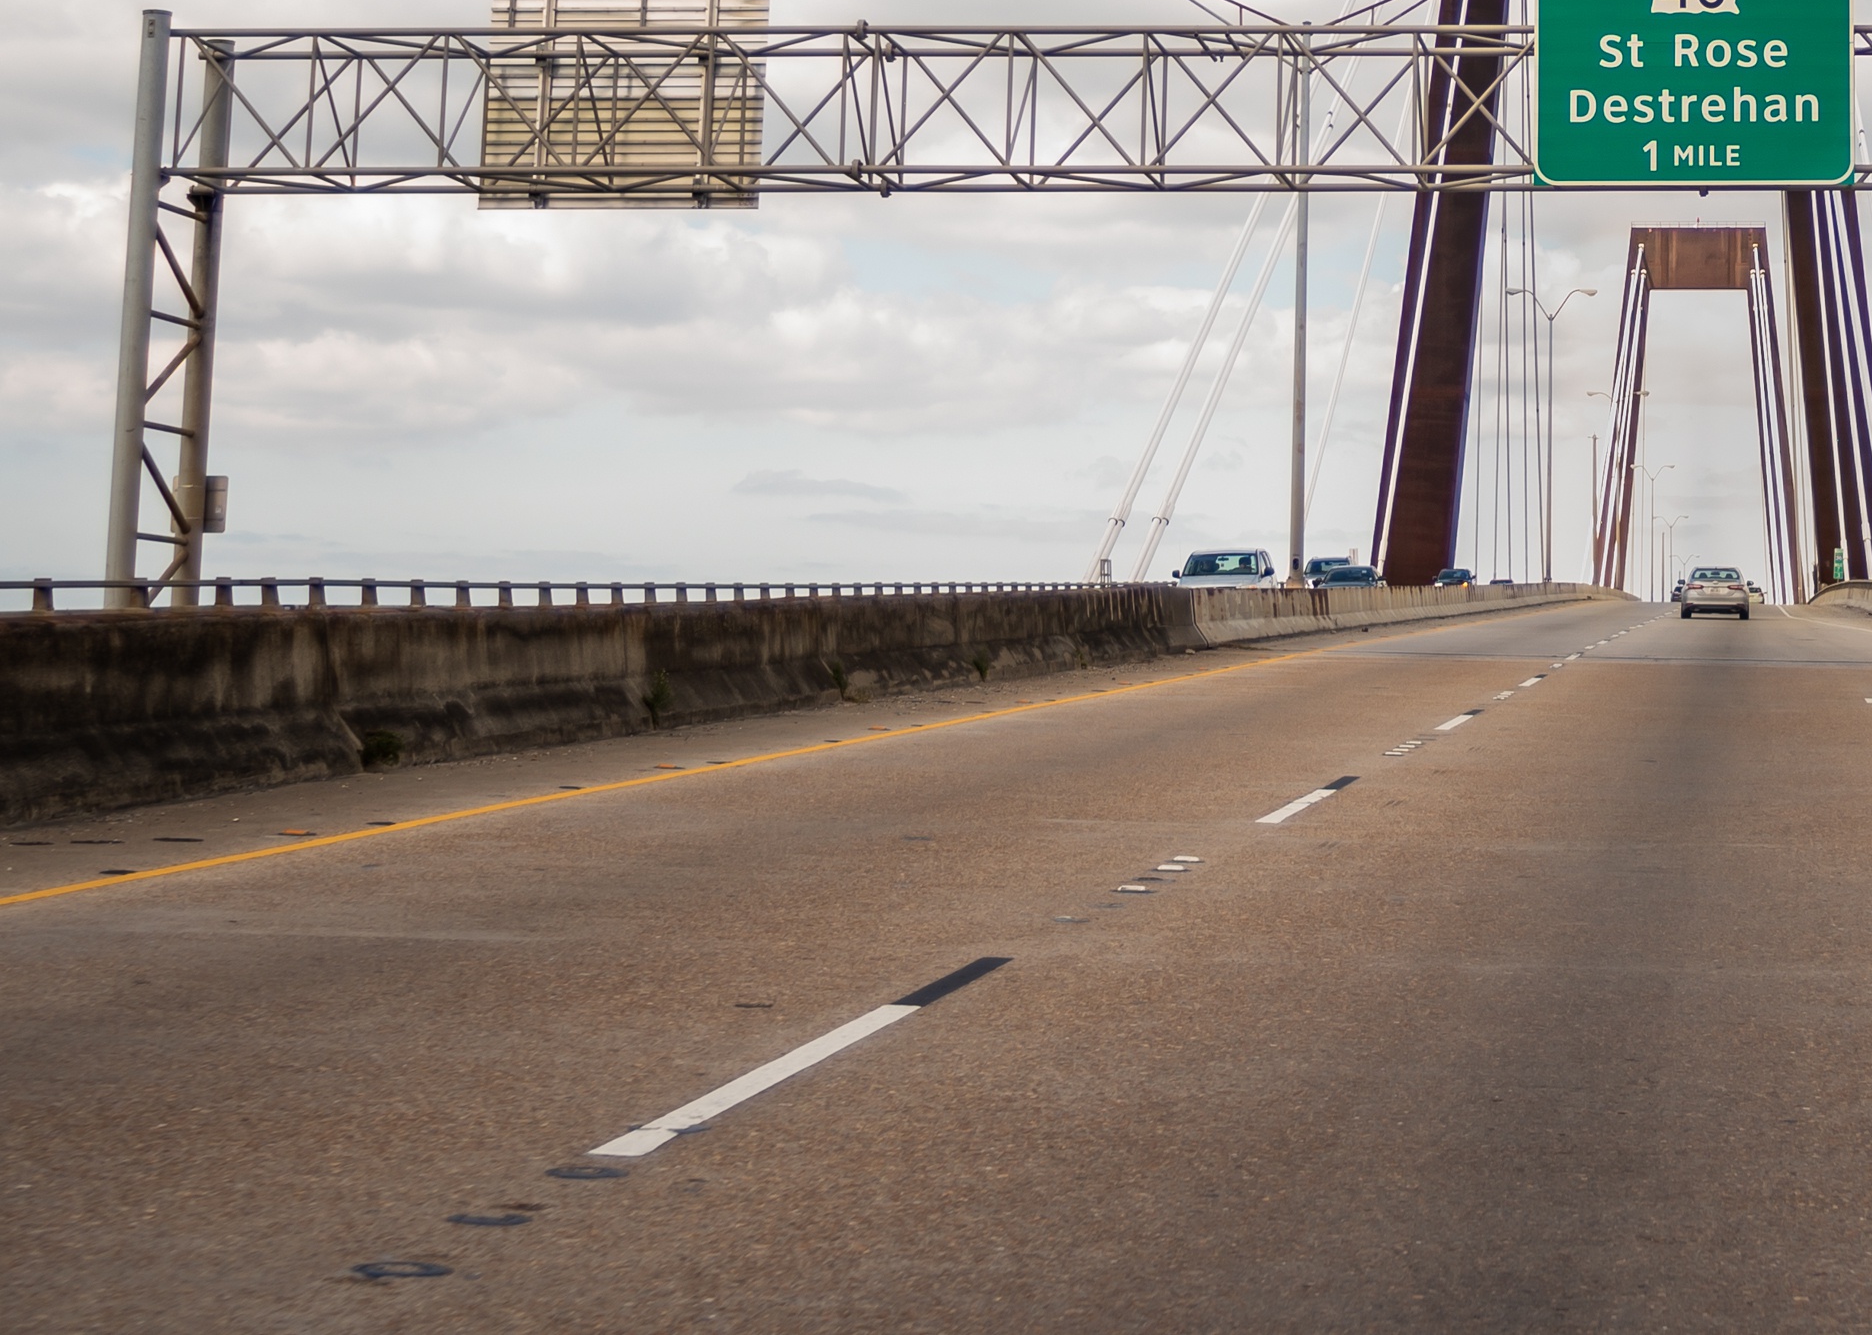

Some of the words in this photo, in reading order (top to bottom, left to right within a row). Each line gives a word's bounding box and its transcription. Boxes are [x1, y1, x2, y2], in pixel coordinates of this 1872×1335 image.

[1599, 34, 1644, 68] St
[1674, 34, 1788, 68] Rose
[1569, 86, 1819, 123] Destrehan
[1642, 140, 1657, 171] 1
[1673, 145, 1741, 166] MILE
